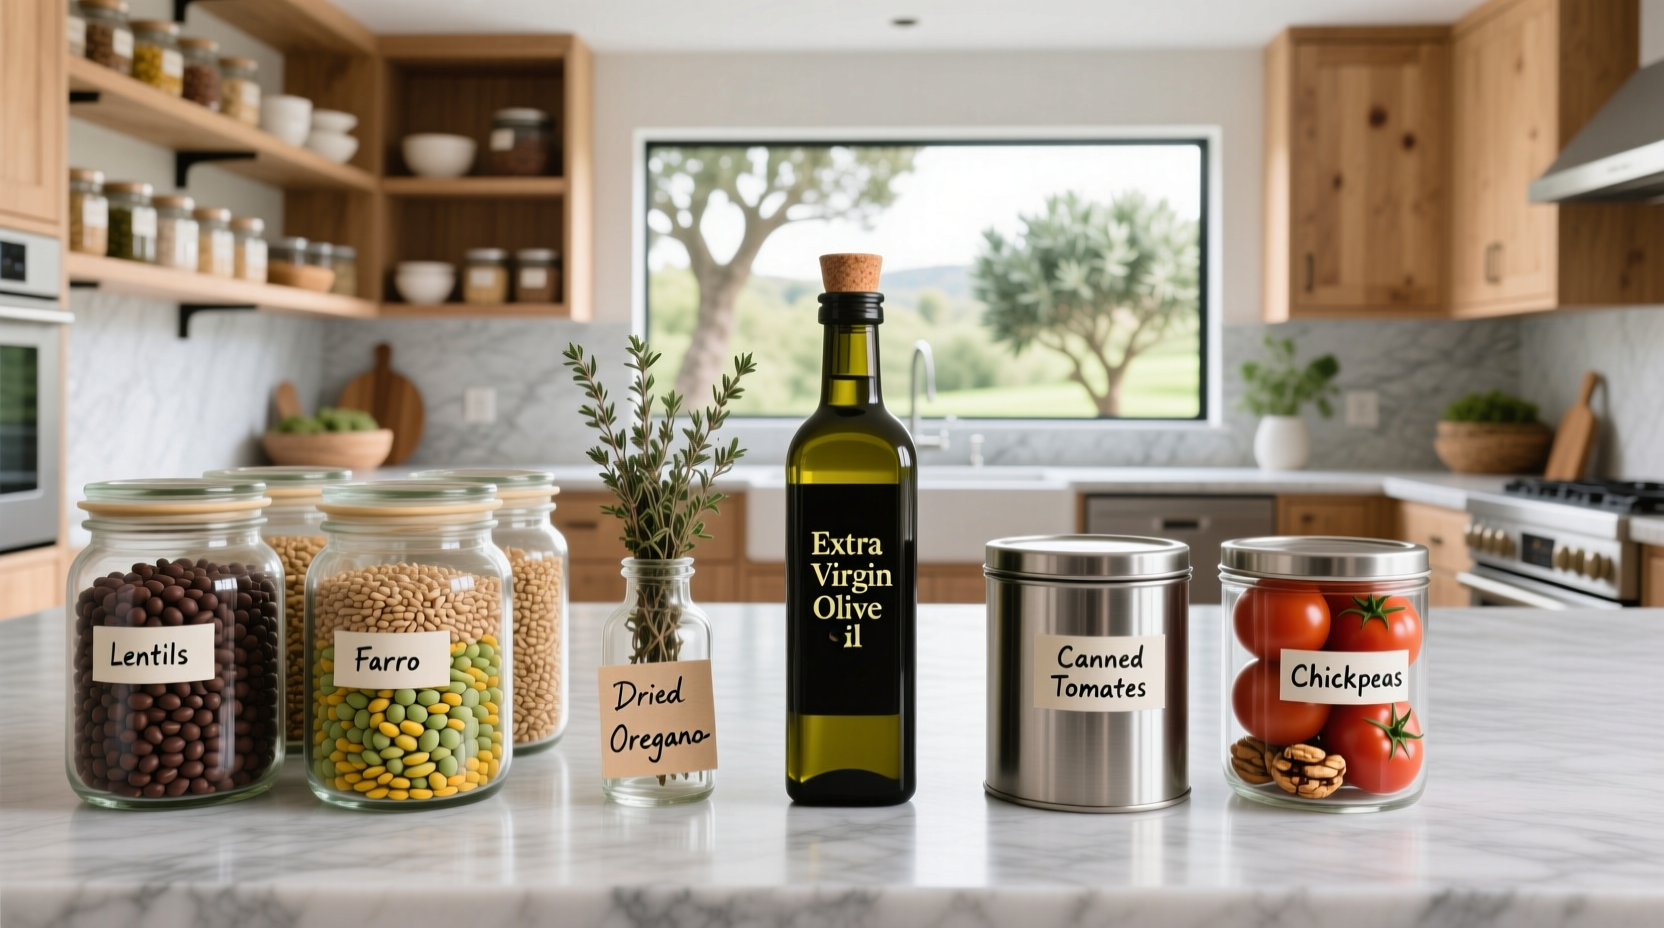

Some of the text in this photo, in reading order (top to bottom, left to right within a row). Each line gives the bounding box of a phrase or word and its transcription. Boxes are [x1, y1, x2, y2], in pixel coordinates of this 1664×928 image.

[811, 531, 883, 556] Extra
[810, 562, 893, 594] Virgin
[813, 594, 883, 620] Olive
[828, 623, 863, 648] il
[110, 641, 189, 667] Lentils
[354, 645, 420, 672] Farro
[1057, 644, 1144, 669] Canned
[613, 675, 686, 711] Dried
[1050, 674, 1146, 698] Tomates
[1291, 663, 1403, 697] Chickpeas
[610, 723, 711, 763] Oregano
